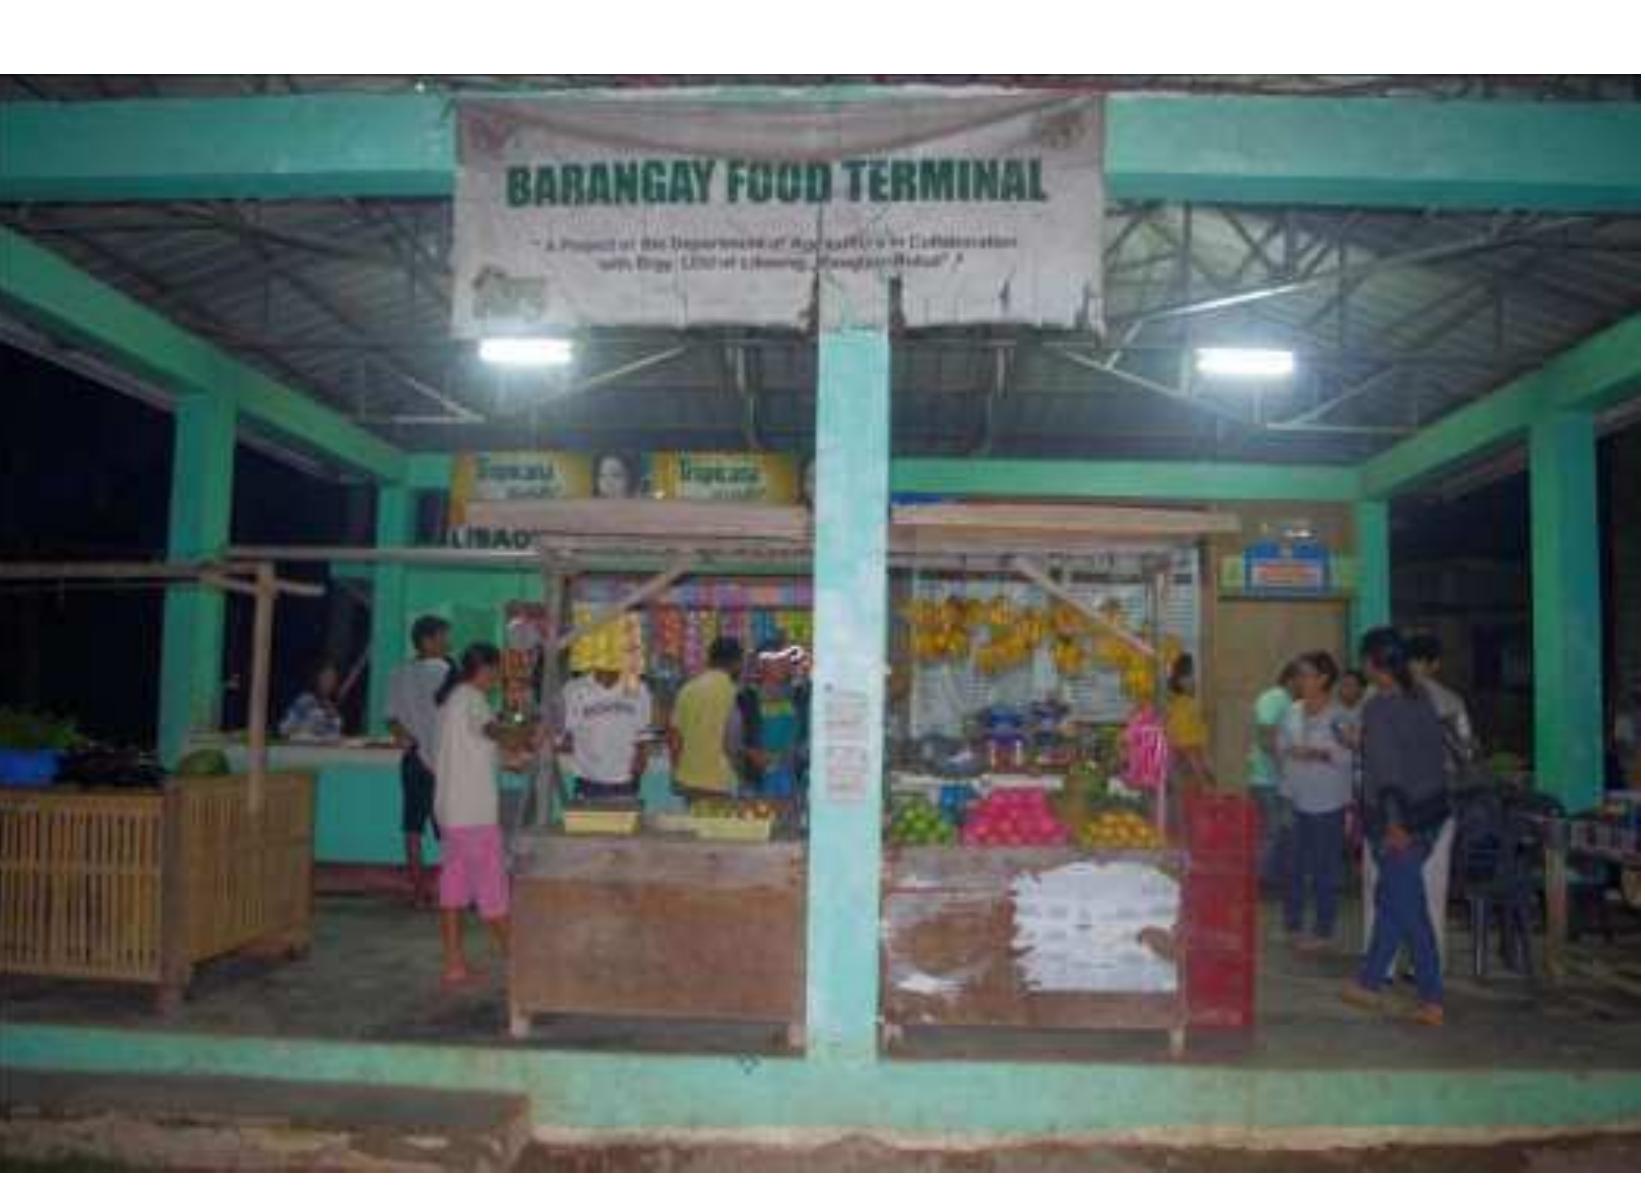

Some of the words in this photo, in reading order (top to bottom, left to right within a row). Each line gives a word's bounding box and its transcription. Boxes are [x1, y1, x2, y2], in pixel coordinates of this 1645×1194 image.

[508, 160, 716, 207] BARANGAY
[727, 160, 832, 202] FOOD
[842, 157, 1048, 201] TERMINAL
